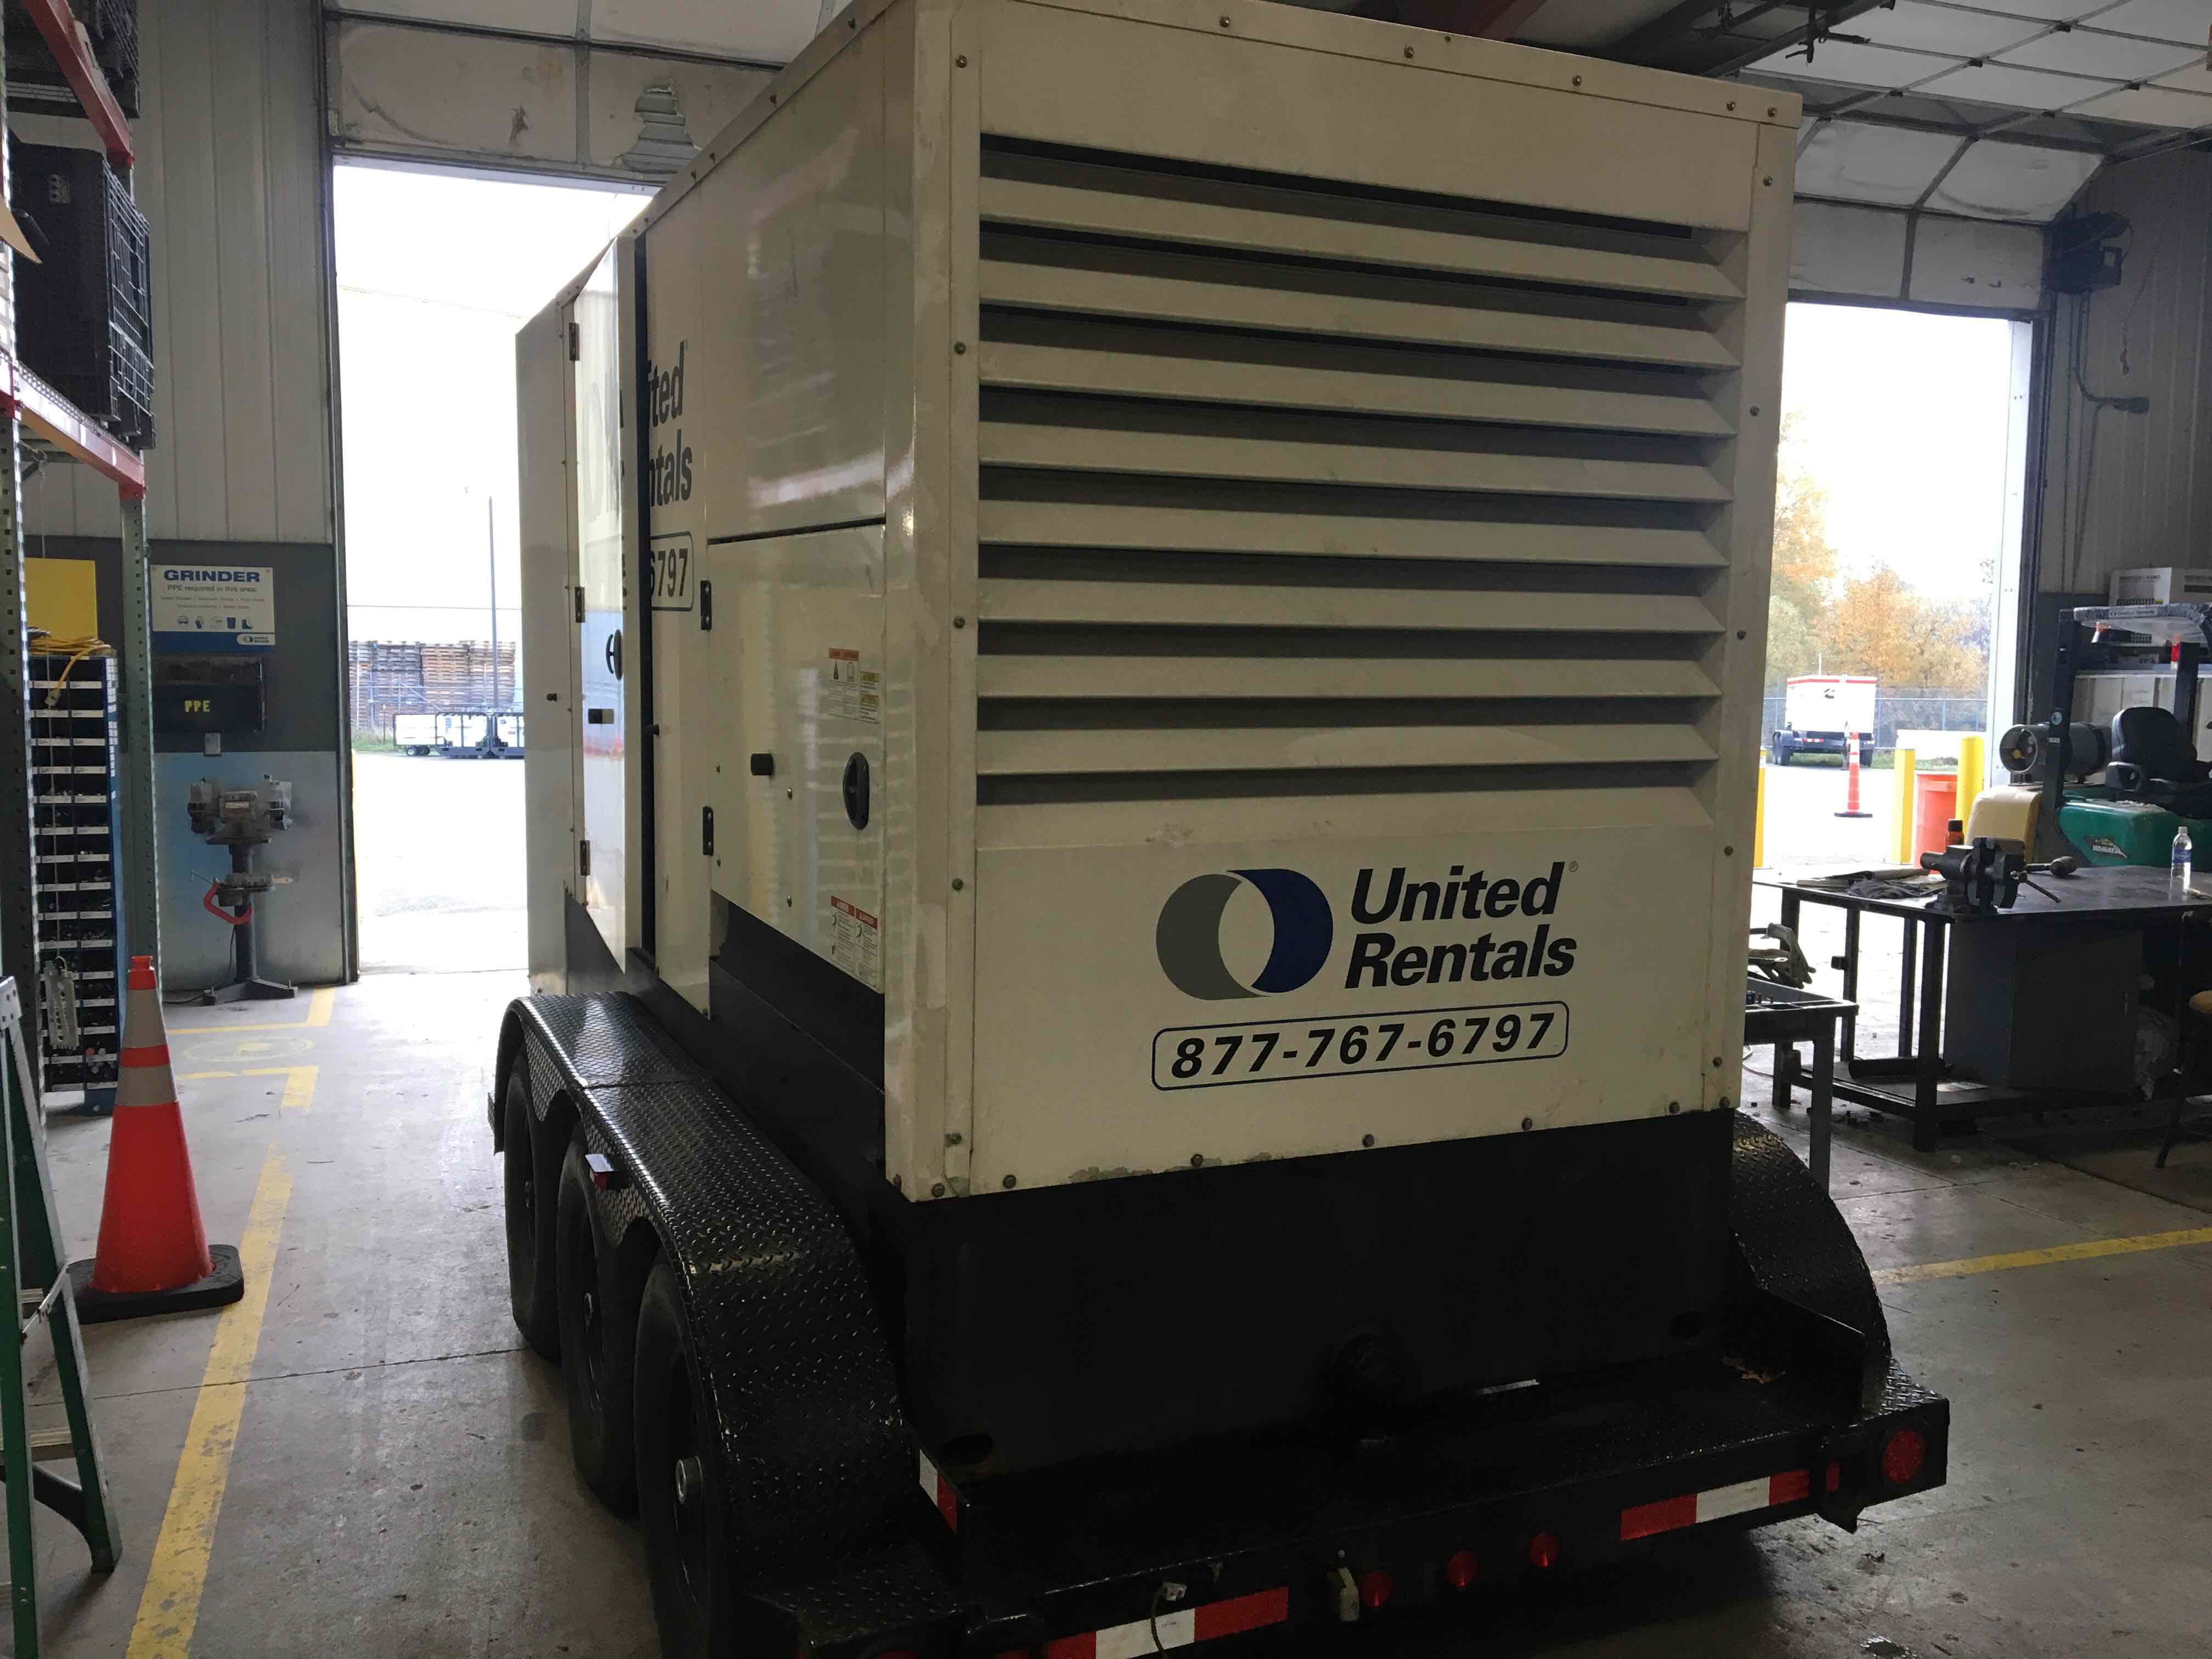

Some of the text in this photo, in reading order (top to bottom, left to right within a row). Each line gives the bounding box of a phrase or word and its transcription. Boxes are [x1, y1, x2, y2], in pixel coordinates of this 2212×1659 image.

[163, 569, 261, 583] GRINDER
[184, 700, 211, 712] PPE
[1351, 862, 1565, 924] United
[1344, 924, 1577, 989] Rentals
[1171, 1013, 1555, 1078] 877-767-6797
